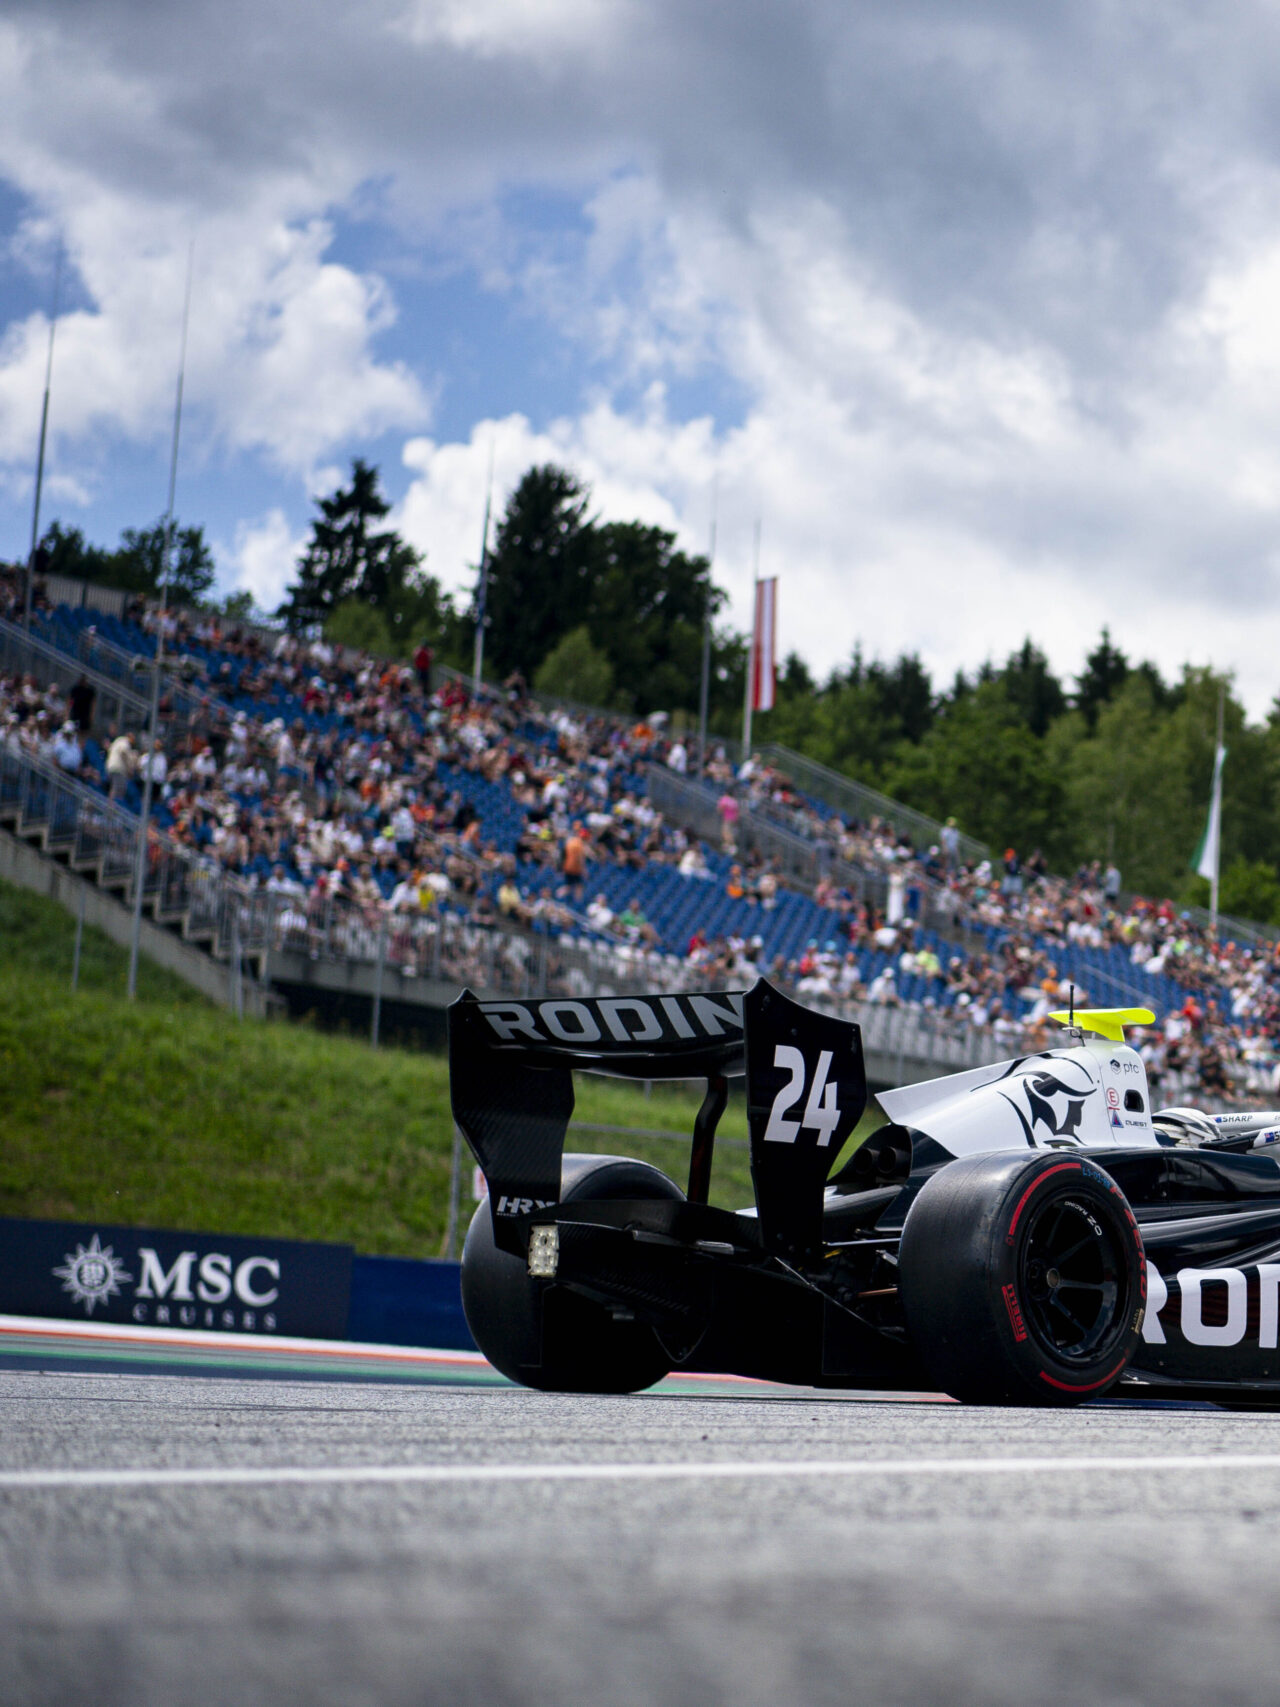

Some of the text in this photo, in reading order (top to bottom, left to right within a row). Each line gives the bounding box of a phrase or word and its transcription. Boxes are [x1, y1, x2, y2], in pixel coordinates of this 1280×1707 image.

[478, 994, 744, 1042] RODIN
[1123, 1062, 1139, 1075] ptc
[764, 1045, 841, 1147] 24
[1222, 1115, 1253, 1123] SHARP
[134, 1248, 281, 1307] MSC
[133, 1305, 278, 1331] CRUISES
